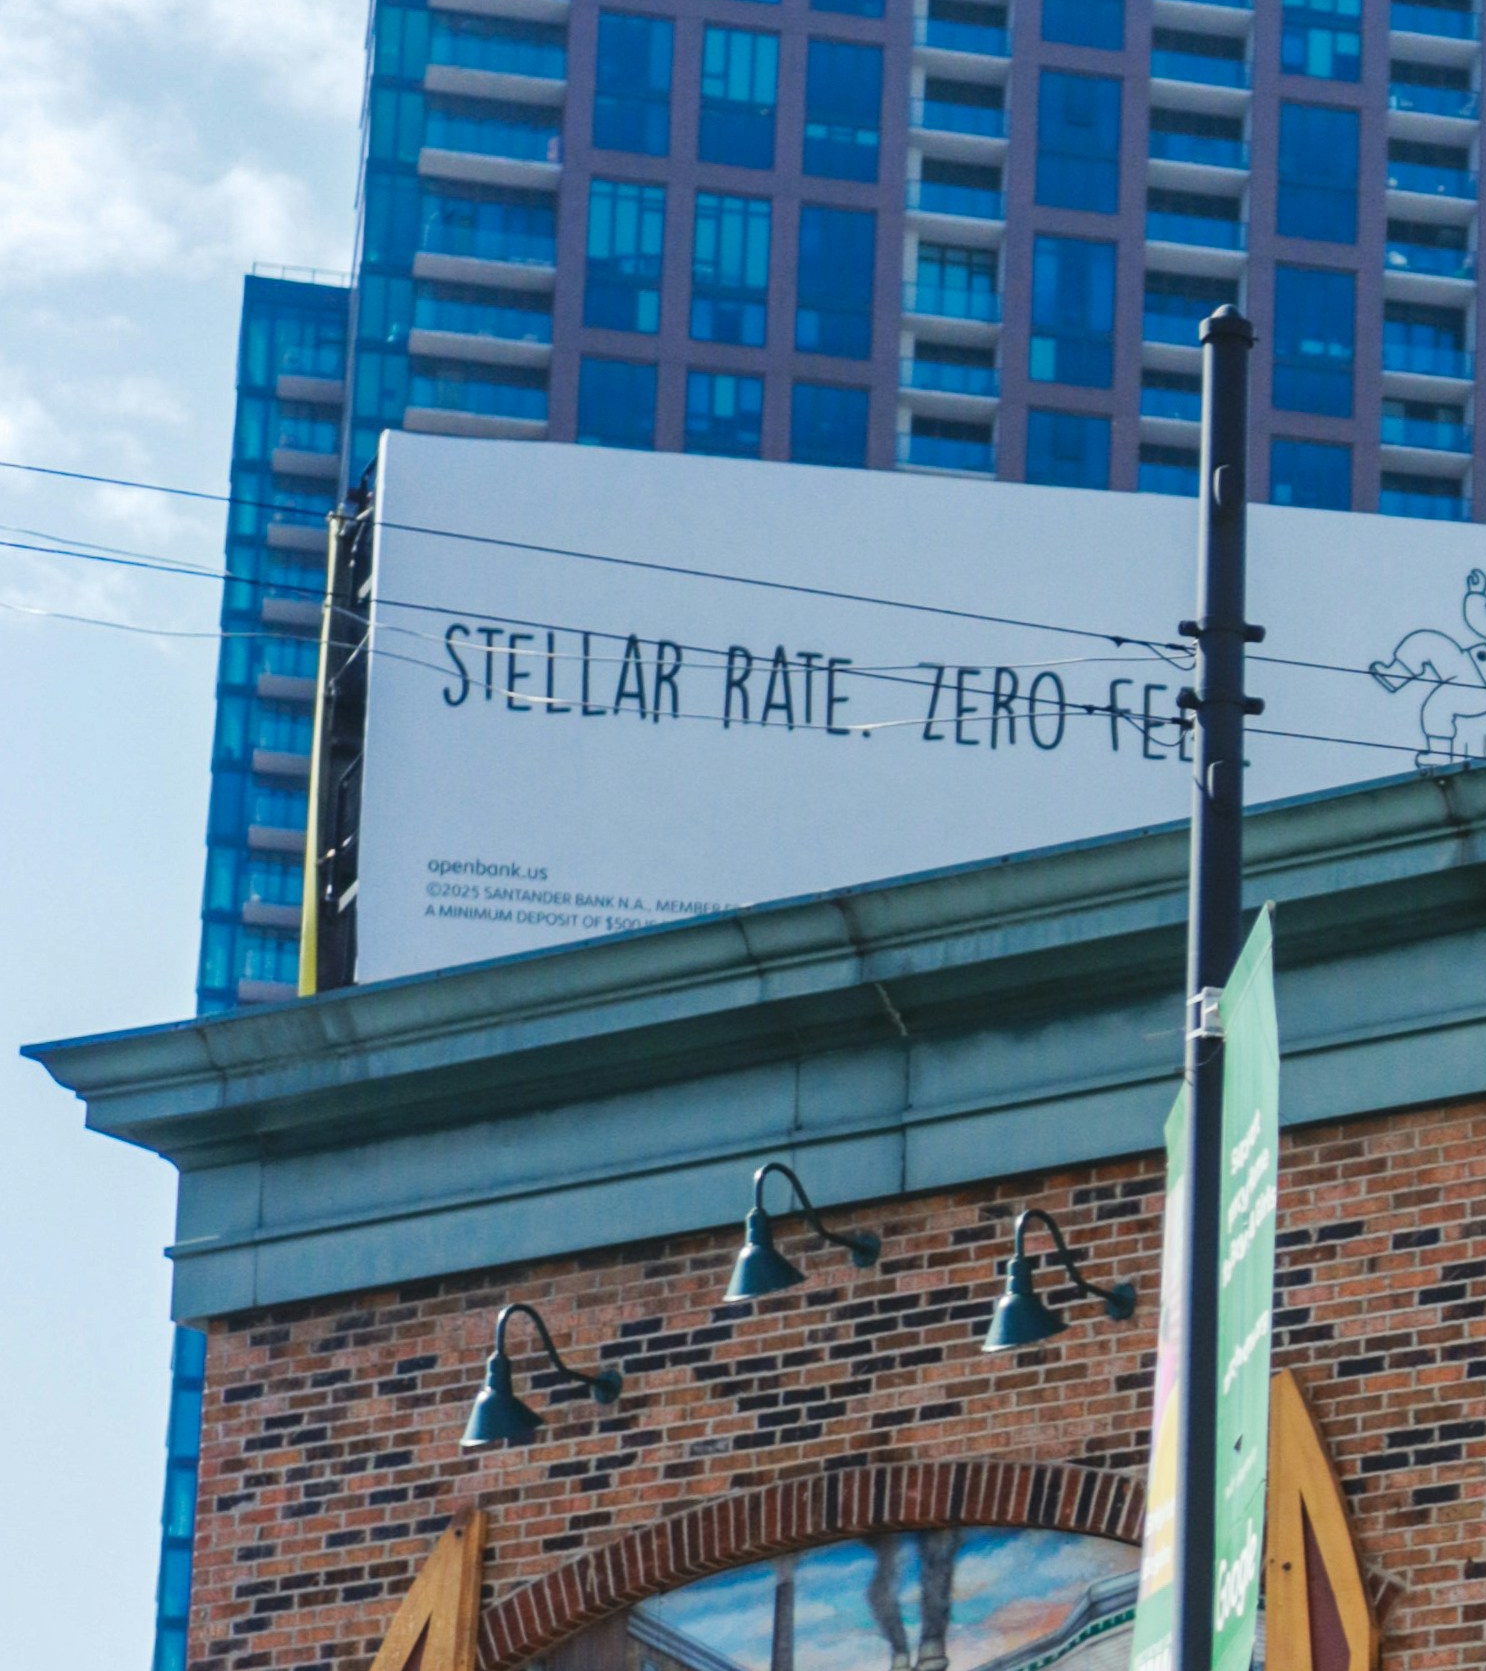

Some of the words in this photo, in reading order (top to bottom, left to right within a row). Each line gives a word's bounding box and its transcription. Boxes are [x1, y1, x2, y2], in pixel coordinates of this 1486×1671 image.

[443, 623, 682, 724] STELLAR
[723, 644, 872, 738] RATE.
[917, 662, 1066, 750] ZERO
[428, 859, 548, 880] openbank.us
[484, 885, 571, 905] SANTANDER
[575, 894, 614, 909] BANK
[656, 899, 721, 914] MEMBER
[425, 904, 436, 916] A
[438, 905, 513, 922] MINIMUM
[516, 910, 577, 926] DEPOSIT
[582, 915, 601, 928] OF
[1216, 1517, 1258, 1632] Google
